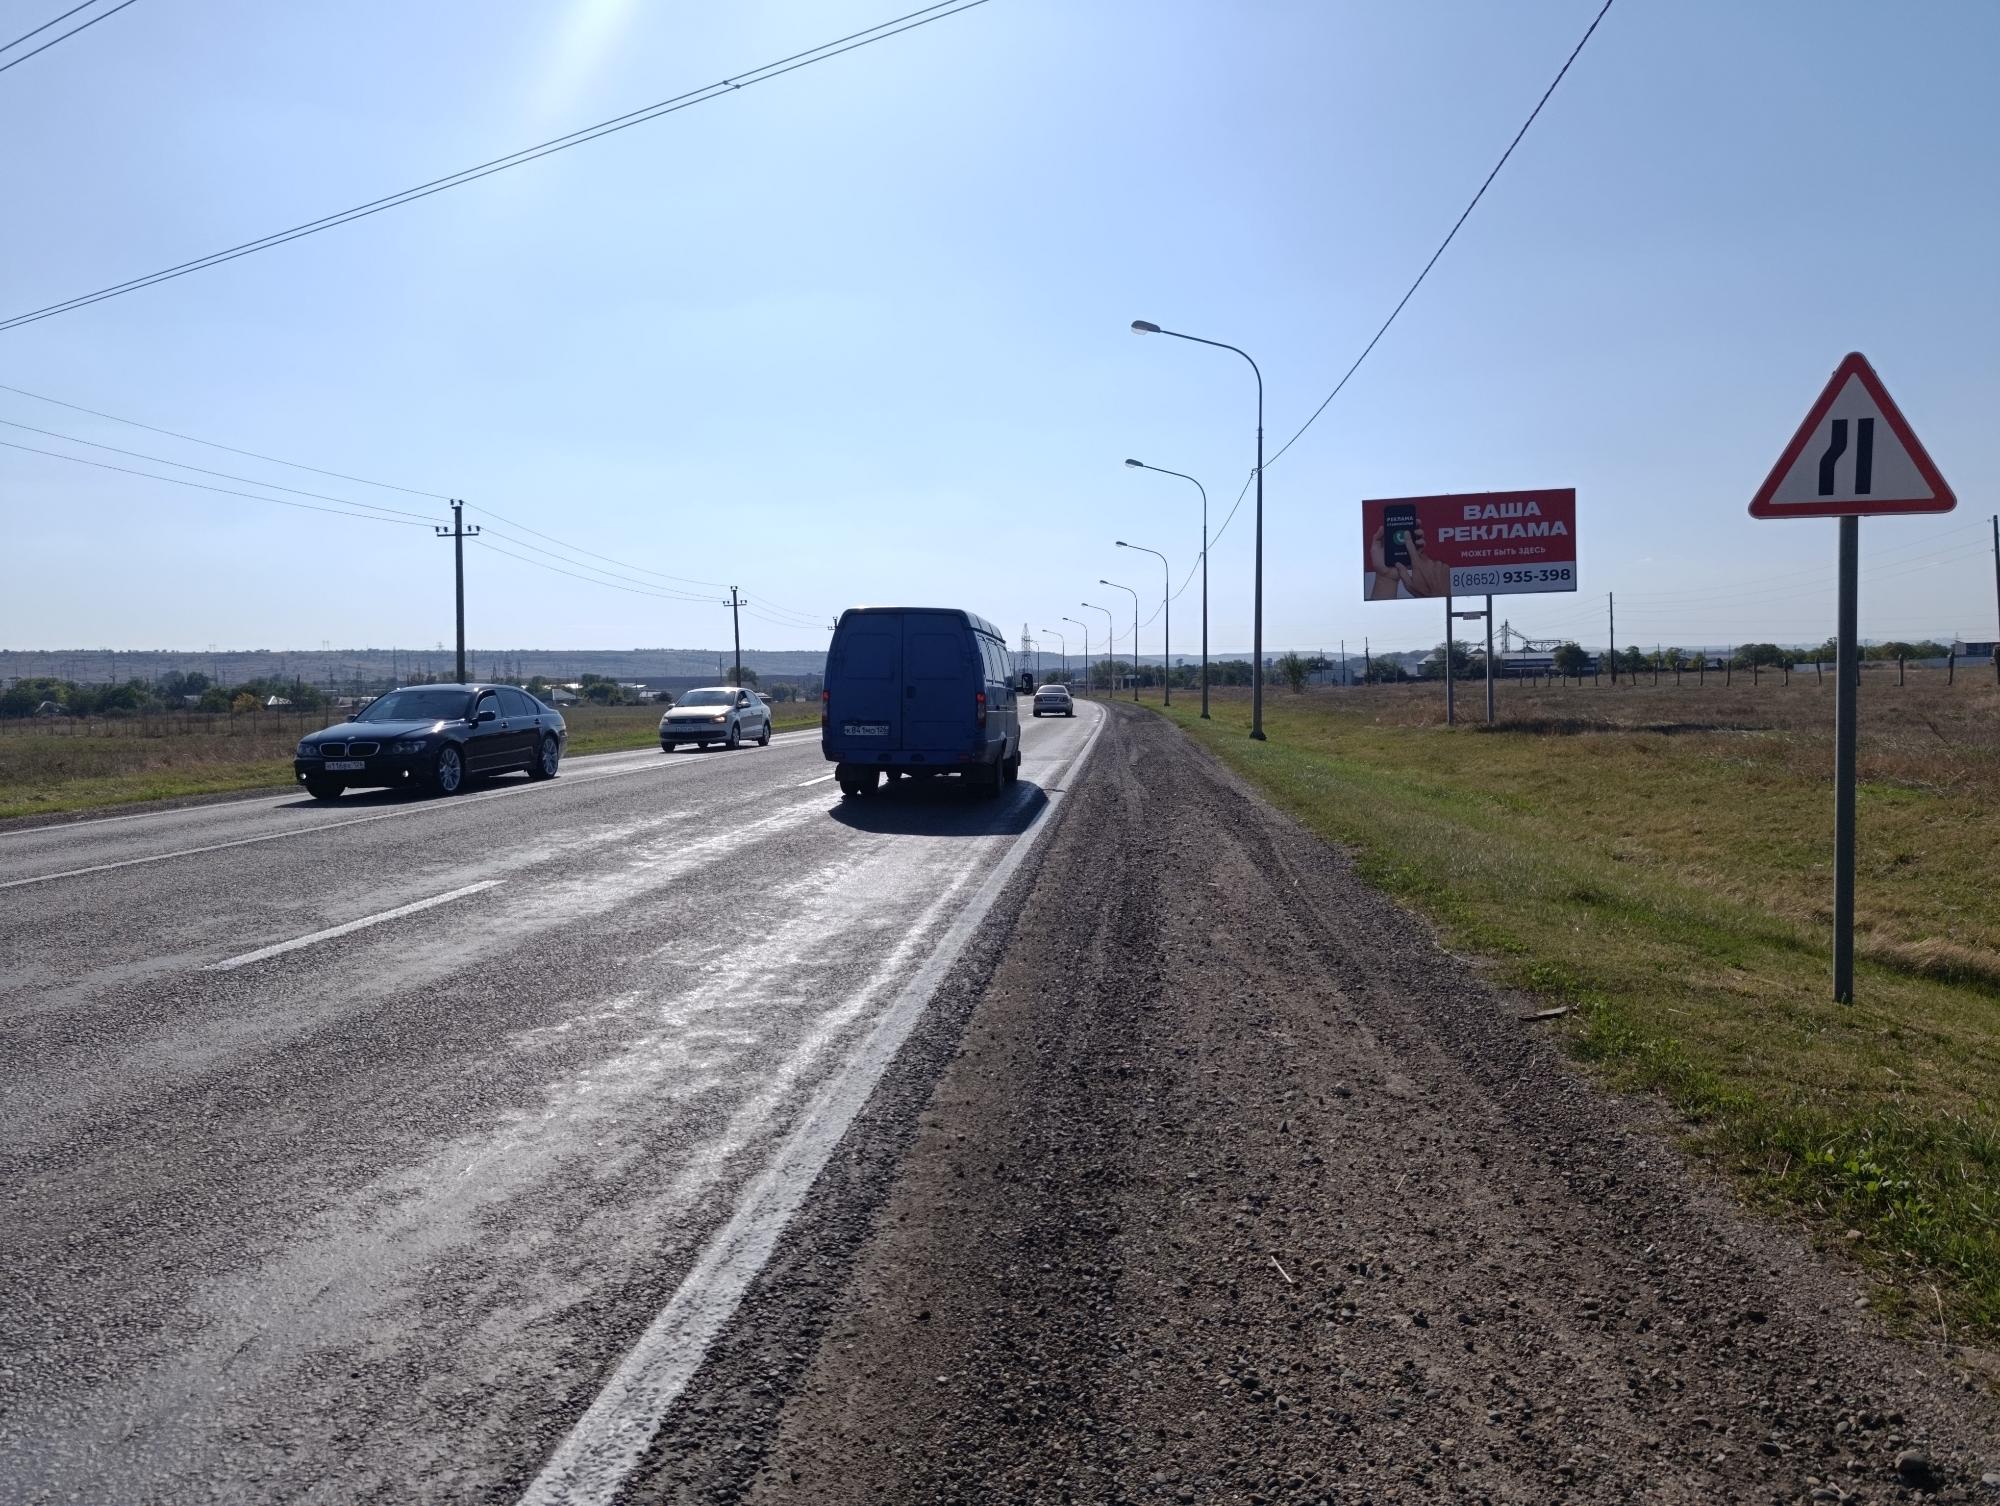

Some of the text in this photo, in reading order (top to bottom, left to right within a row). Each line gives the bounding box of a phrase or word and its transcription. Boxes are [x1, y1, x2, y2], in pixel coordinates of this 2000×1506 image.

[1463, 501, 1541, 520] ВАША
[1438, 520, 1568, 543] РЕКЛАМА
[1461, 546, 1546, 558] МОЖЕТ БЫТЬ ЗДЕСЬ
[1452, 568, 1571, 588] 8(8652) 935-398
